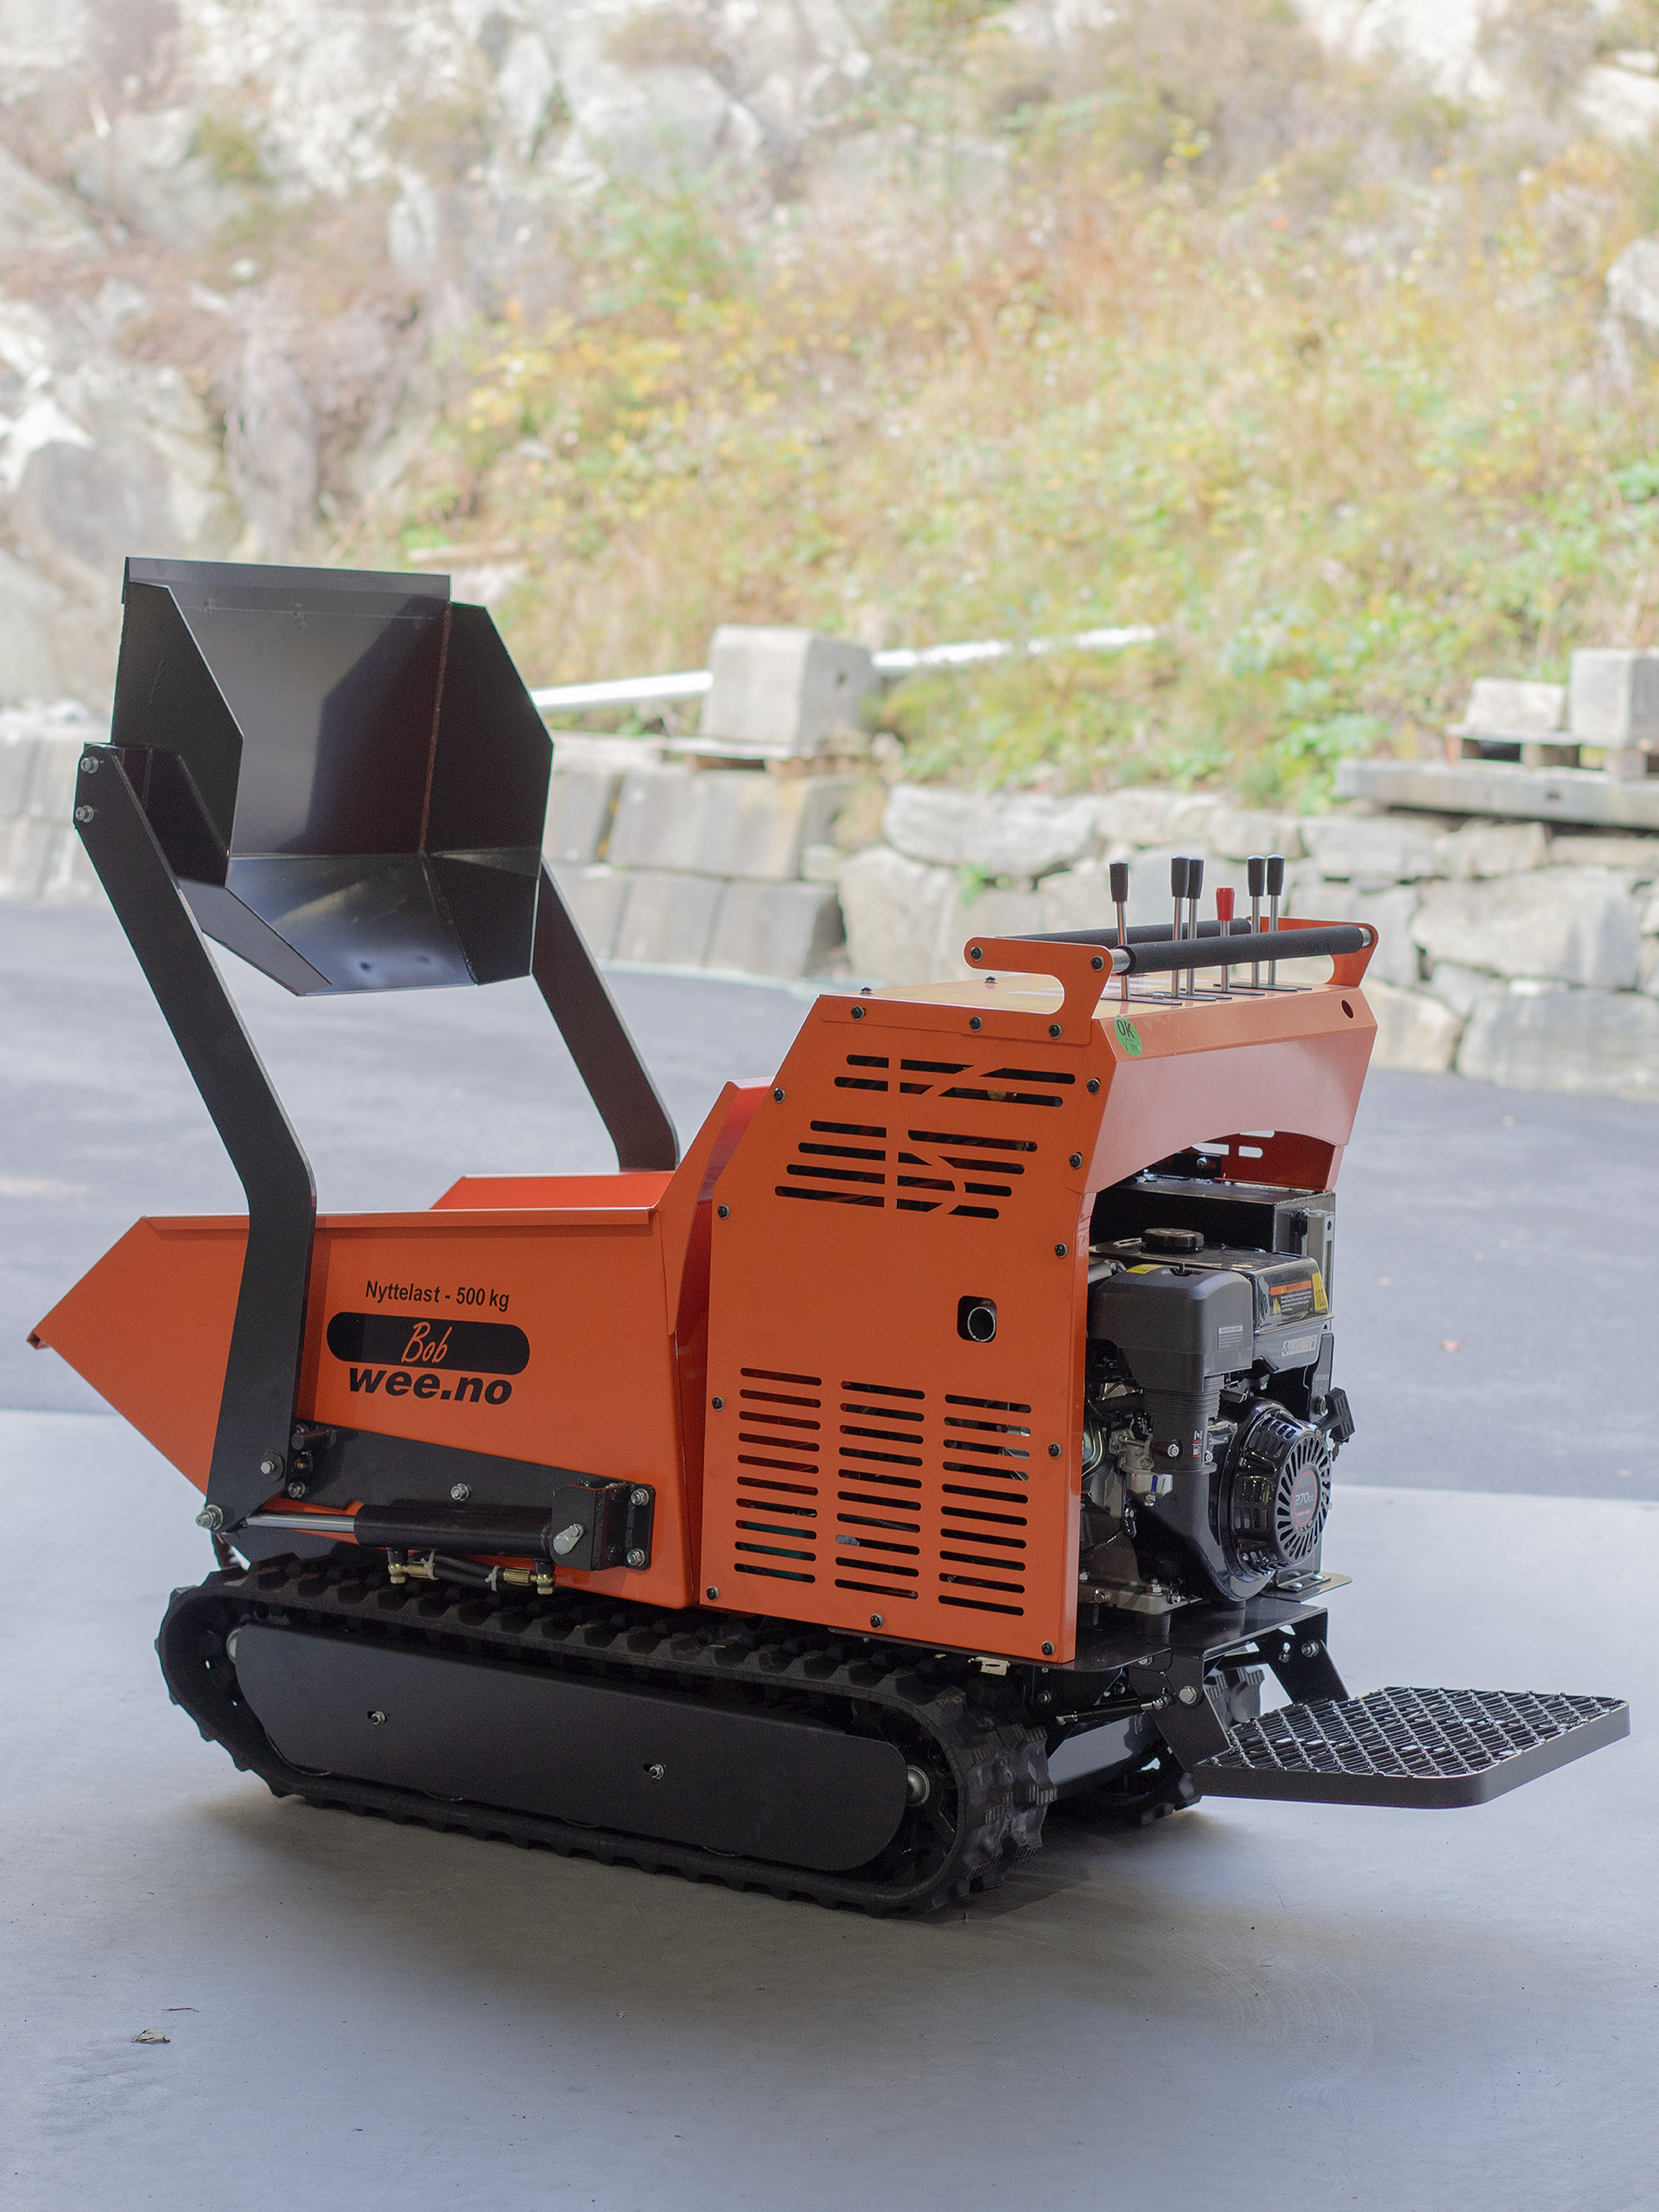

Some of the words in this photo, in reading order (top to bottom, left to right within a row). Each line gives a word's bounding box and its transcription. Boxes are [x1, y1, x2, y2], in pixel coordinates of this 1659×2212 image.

[1116, 1020, 1135, 1039] OK
[365, 1280, 440, 1303] Nyttelast
[456, 1287, 485, 1306] 500
[489, 1289, 510, 1313] kg
[401, 1321, 453, 1363] Bob
[349, 1367, 512, 1405] wee.no
[1294, 1491, 1314, 1506] 270cc
